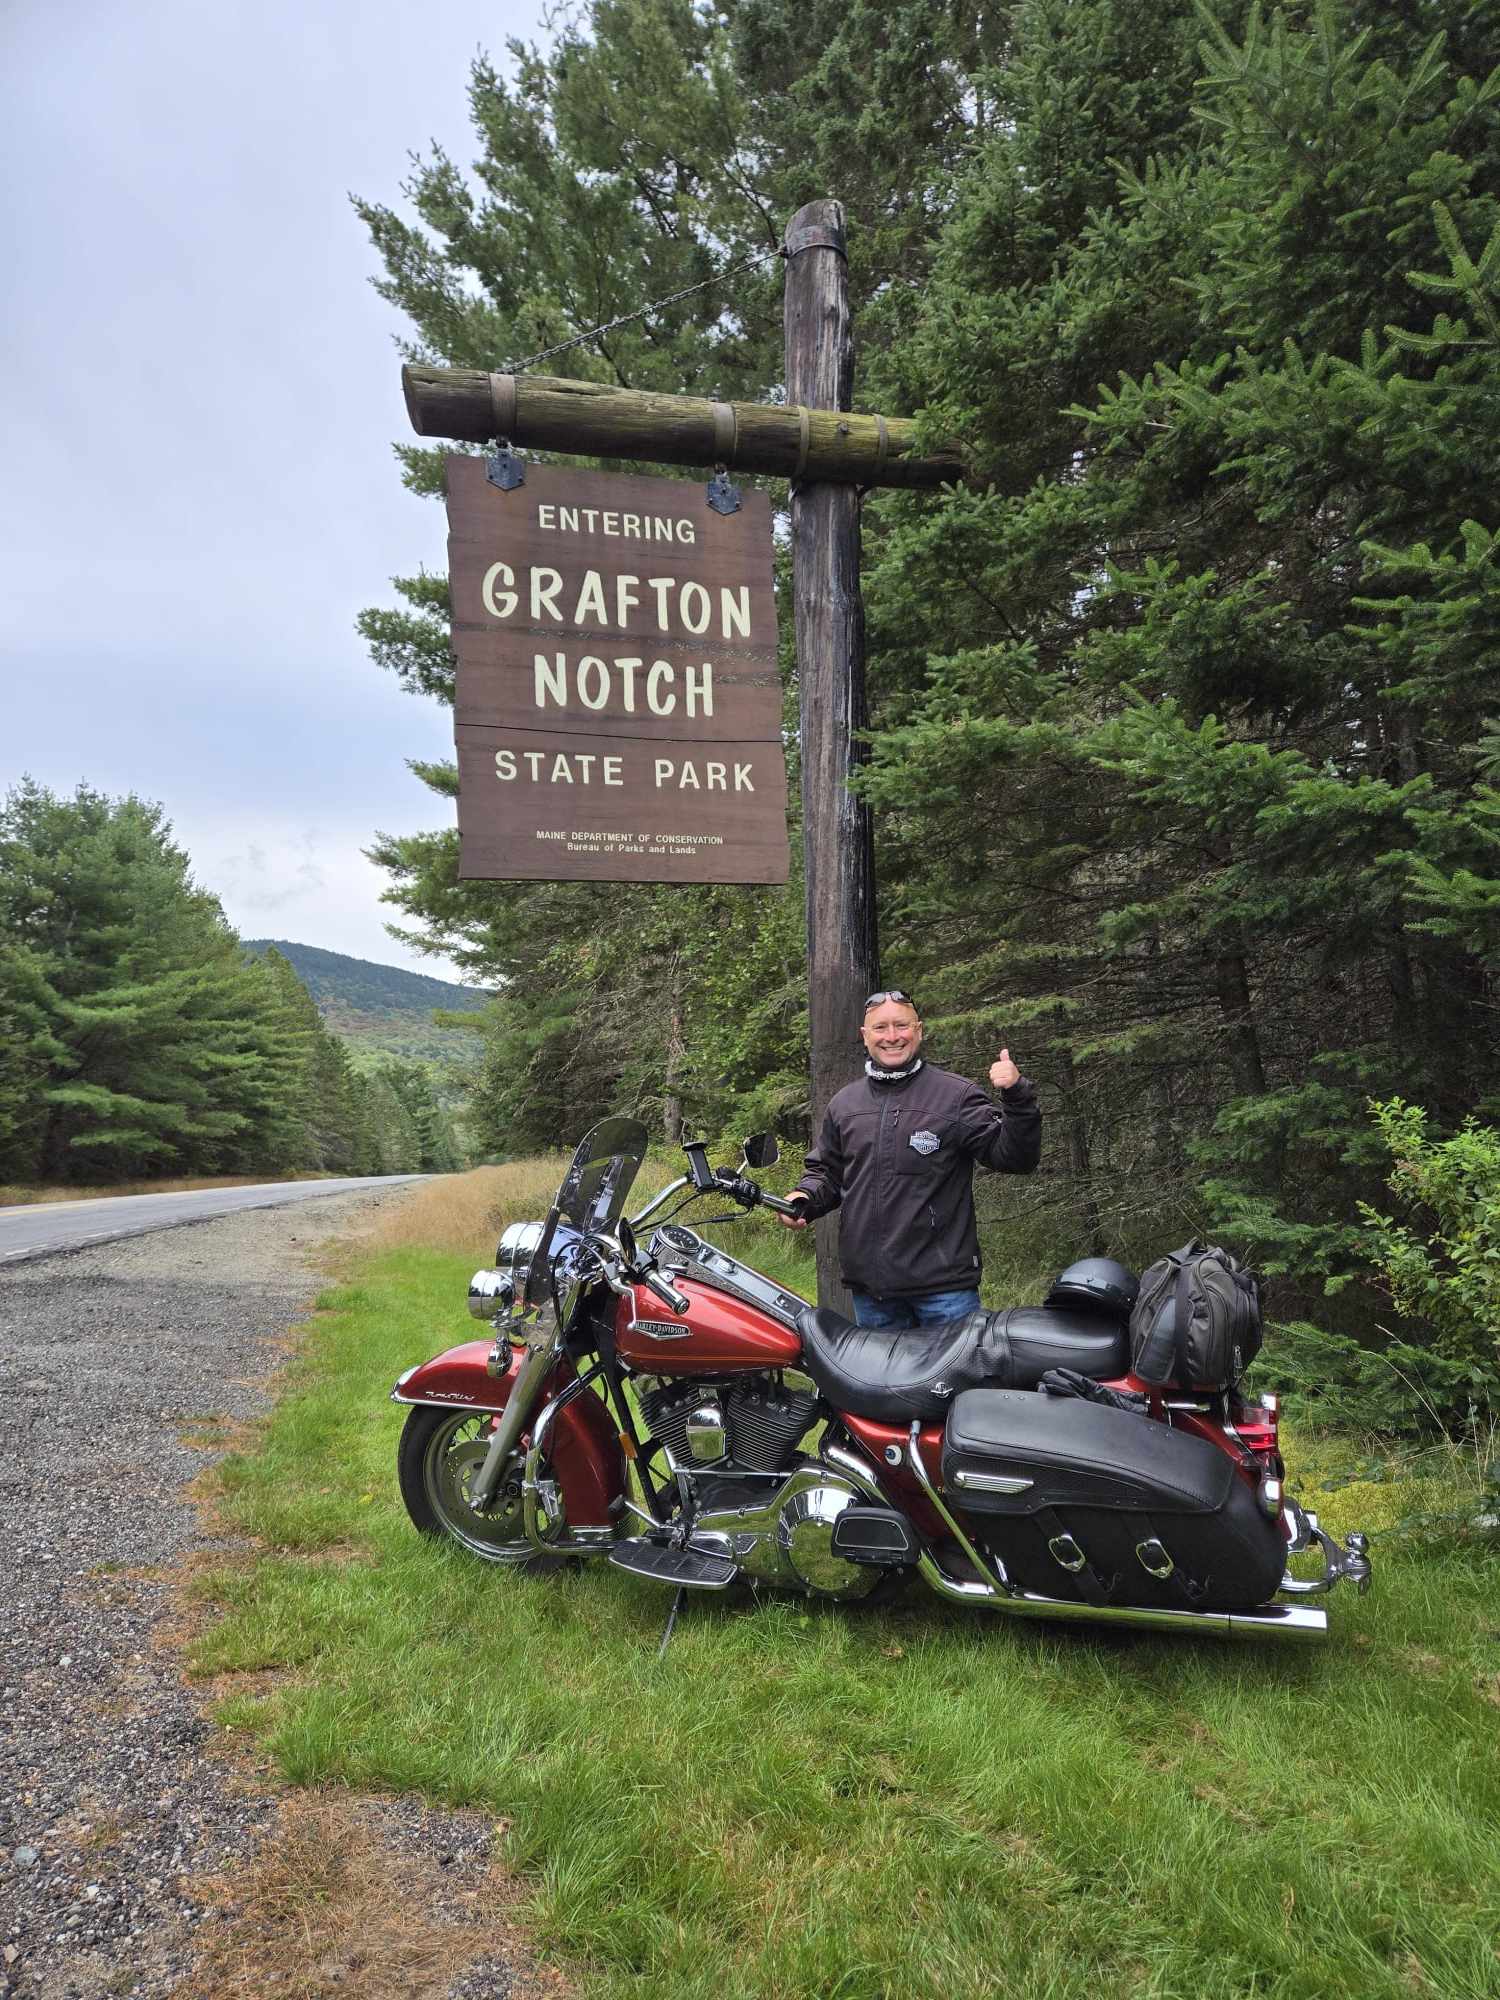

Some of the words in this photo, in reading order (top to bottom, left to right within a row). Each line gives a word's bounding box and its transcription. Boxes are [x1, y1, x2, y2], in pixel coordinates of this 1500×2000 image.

[538, 505, 696, 544] ENTERING
[482, 561, 751, 638] GRAFTON
[534, 652, 714, 718] NOTCH
[495, 750, 624, 786] STATE
[655, 758, 755, 792] PARK
[536, 830, 566, 840] MAINE
[571, 831, 633, 842] DEPARTMENT
[638, 834, 650, 842] OF
[655, 834, 724, 845] CONSERVATION
[567, 842, 599, 851] Bureau
[604, 843, 614, 851] of
[618, 843, 644, 853] Parks
[648, 845, 665, 853] and
[669, 845, 696, 855] Lands
